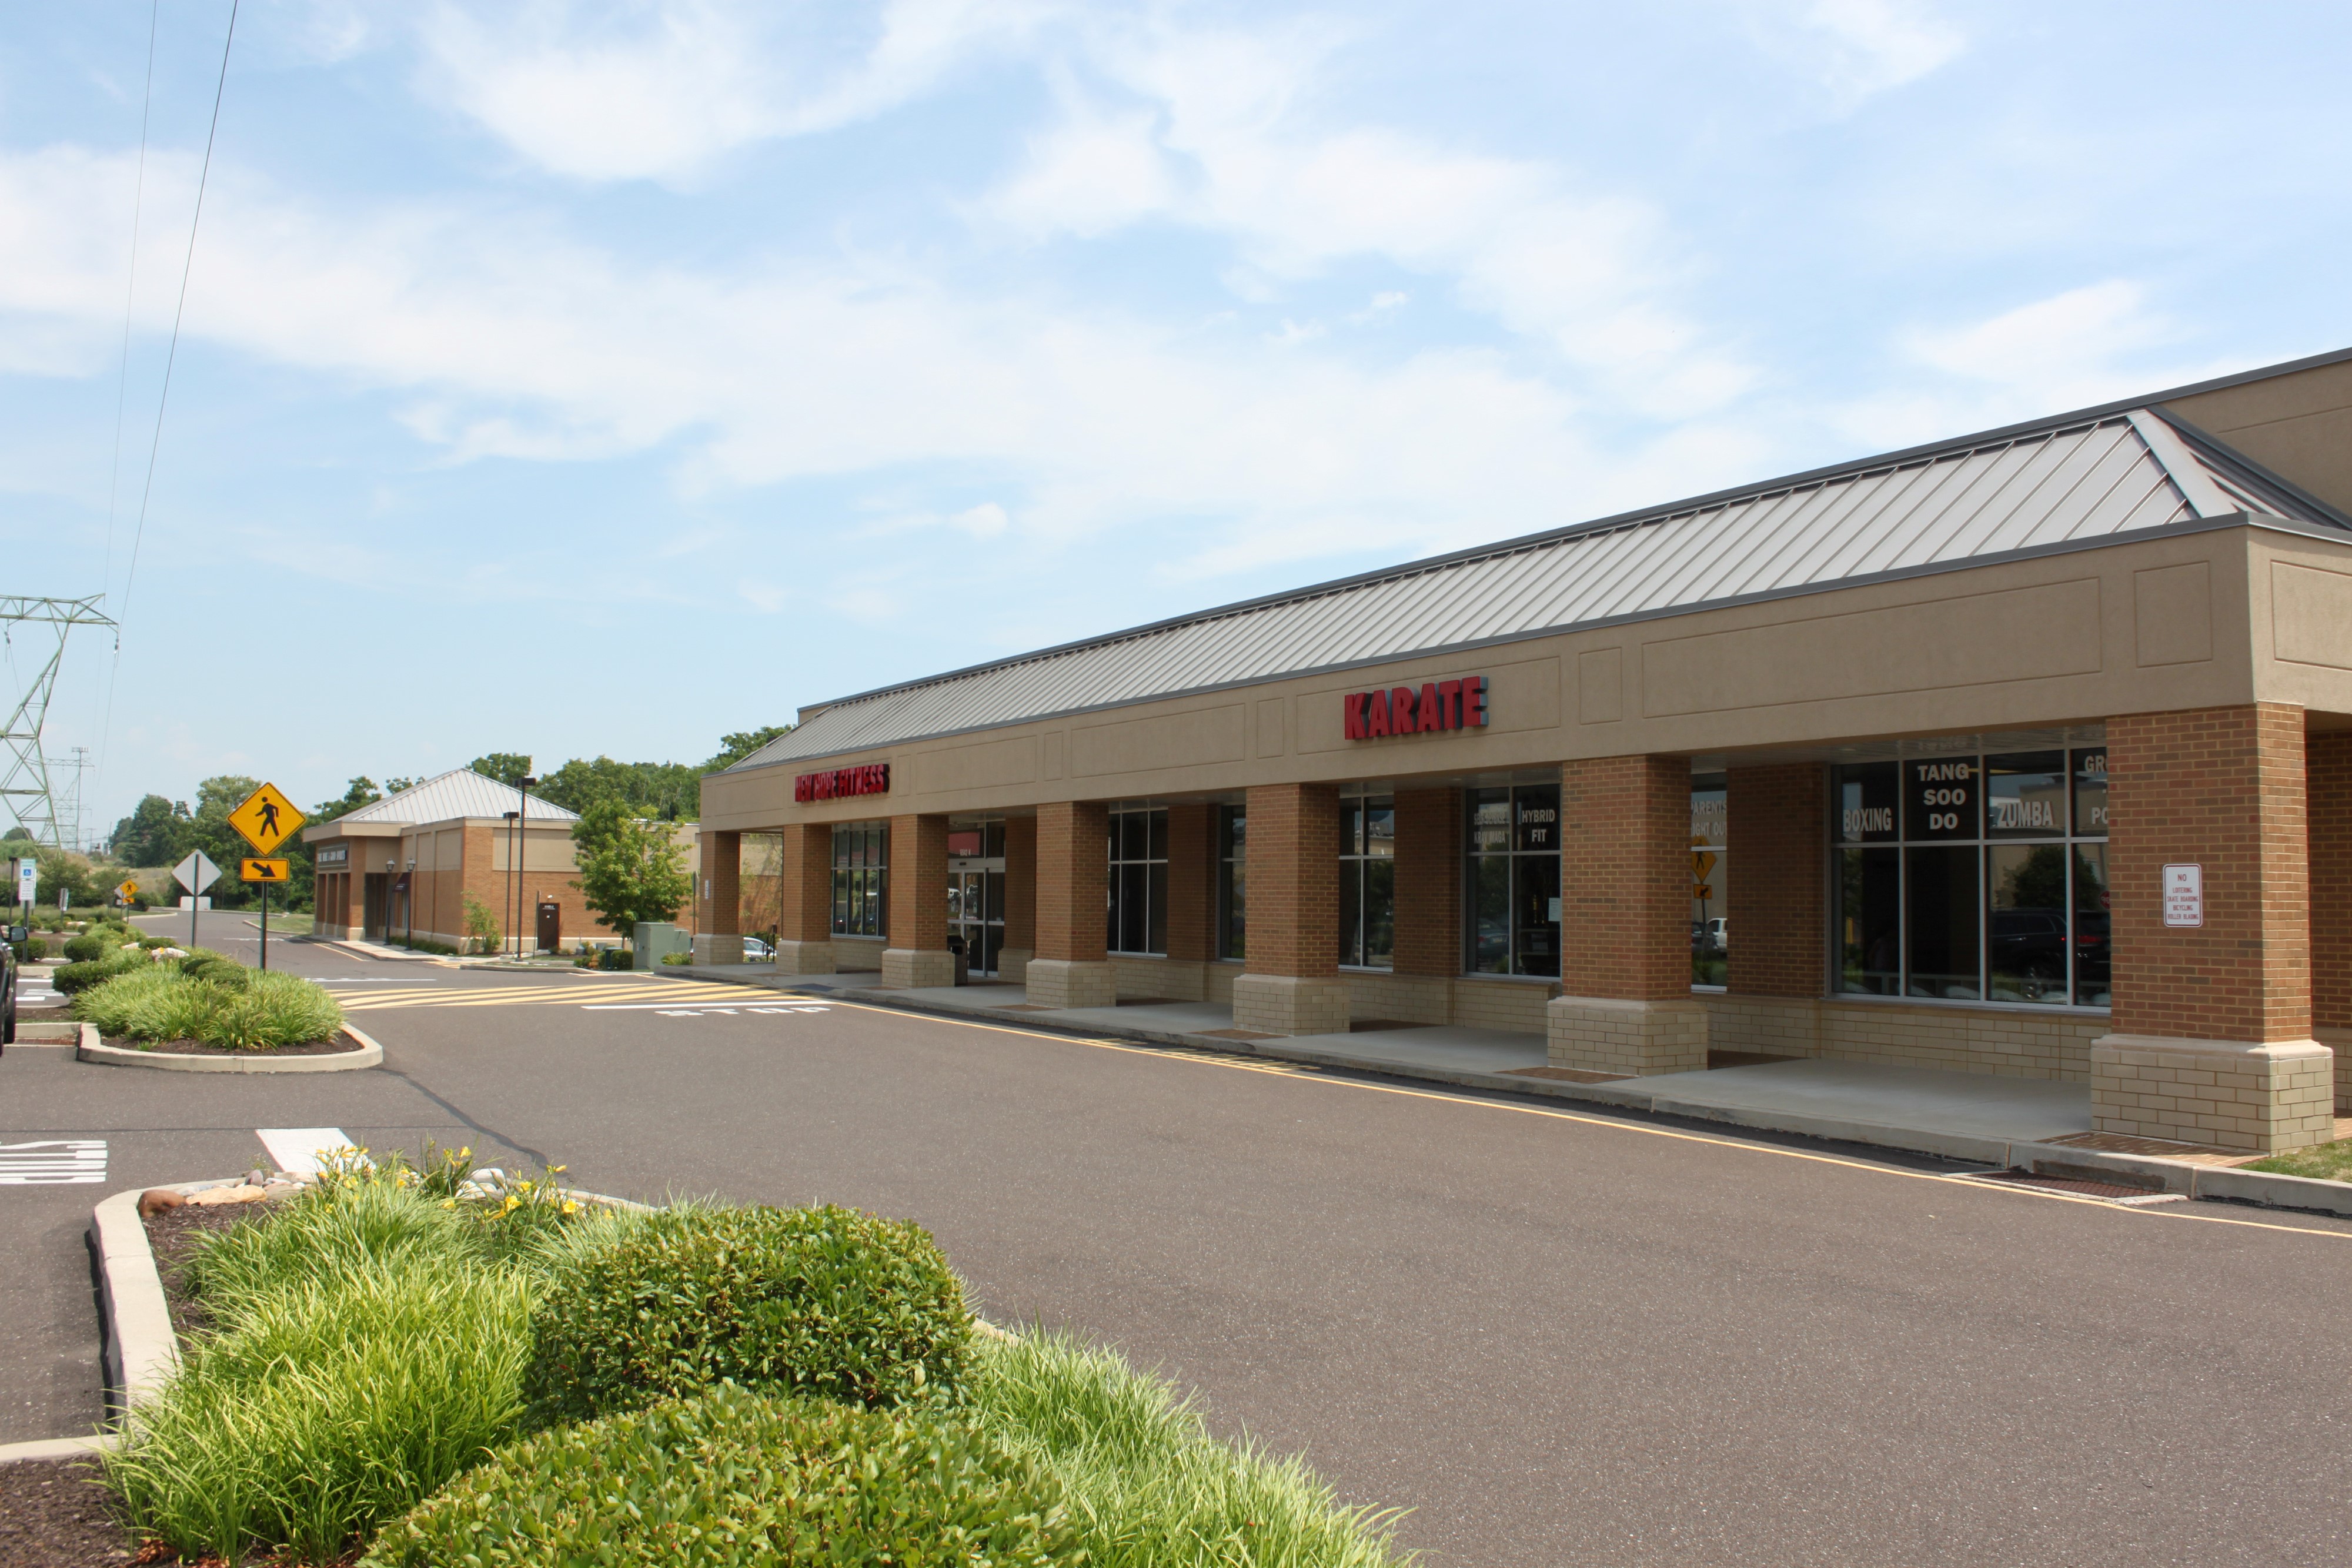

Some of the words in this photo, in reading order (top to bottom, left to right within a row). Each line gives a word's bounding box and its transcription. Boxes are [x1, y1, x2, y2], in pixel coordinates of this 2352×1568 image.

[1345, 676, 1488, 740] KARATE
[1917, 763, 1969, 781] TANG
[2084, 755, 2108, 772] GR
[795, 774, 813, 802] NEW
[814, 770, 838, 800] HOPE
[838, 764, 890, 797] FITNESS
[1923, 788, 1966, 805] SOO
[1522, 809, 1555, 823] HYBRID
[1843, 808, 1892, 833] BOXING
[1929, 813, 1958, 830] DO
[1997, 801, 2053, 828] ZUMBA
[1489, 831, 1506, 844] MAGA
[1532, 829, 1547, 842] FIT
